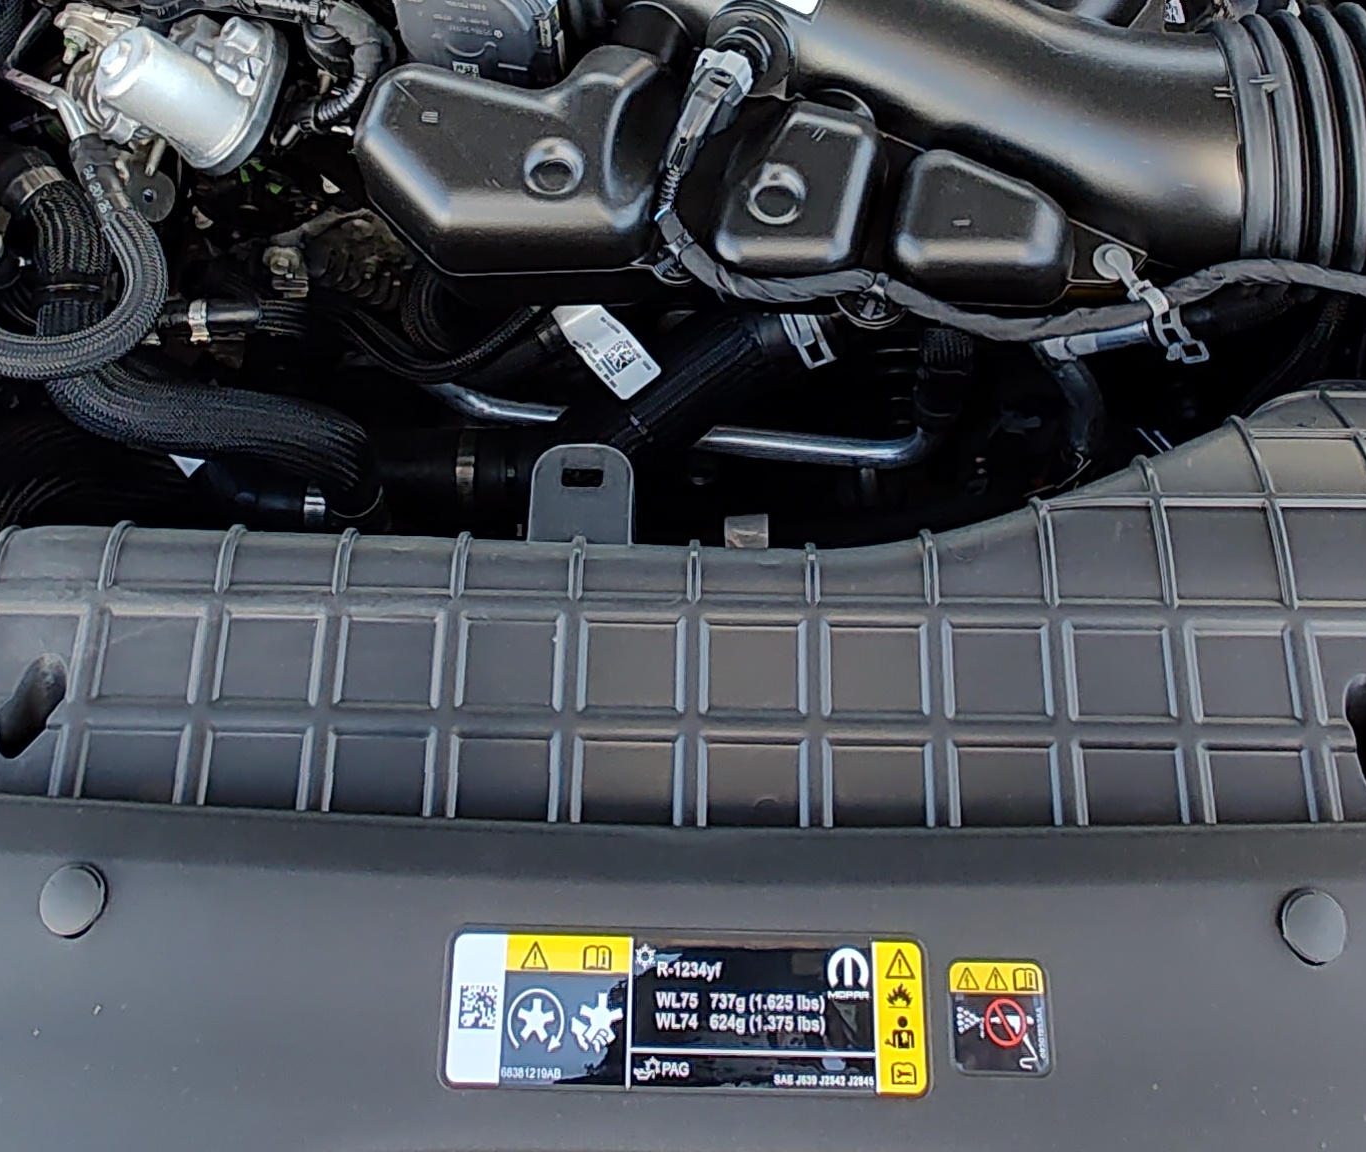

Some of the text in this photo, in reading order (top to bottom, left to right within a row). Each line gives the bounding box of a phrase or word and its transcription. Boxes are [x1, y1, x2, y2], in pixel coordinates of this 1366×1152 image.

[656, 960, 723, 983] R-1234yf
[655, 991, 826, 1015] WL75 737g (1.625 lbs)
[827, 990, 870, 1000] MOPAR
[655, 1012, 826, 1036] WL74 624g (1.375 lbs)
[661, 1061, 690, 1078] PAG
[773, 1073, 794, 1086] SAE
